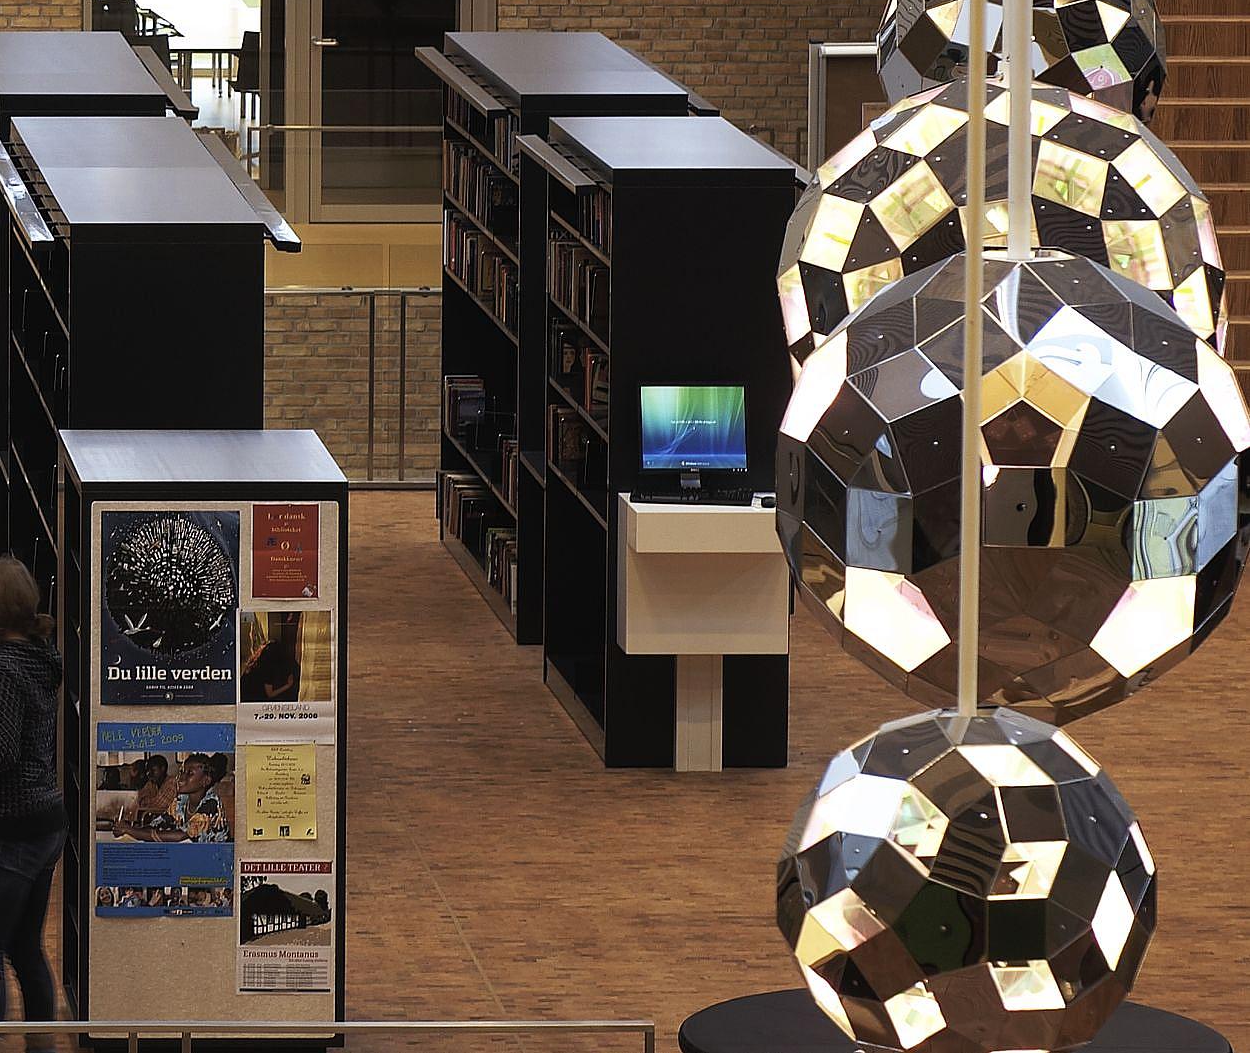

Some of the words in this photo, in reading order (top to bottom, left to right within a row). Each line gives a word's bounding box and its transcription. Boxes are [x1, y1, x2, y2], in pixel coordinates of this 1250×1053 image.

[107, 666, 132, 681] Du
[135, 665, 167, 681] lille
[170, 665, 232, 681] verden
[244, 863, 262, 872] DET
[262, 863, 287, 872] LILLE
[287, 863, 321, 872] TEATER
[242, 950, 278, 958] Erasmus
[278, 950, 319, 958] Montanus
